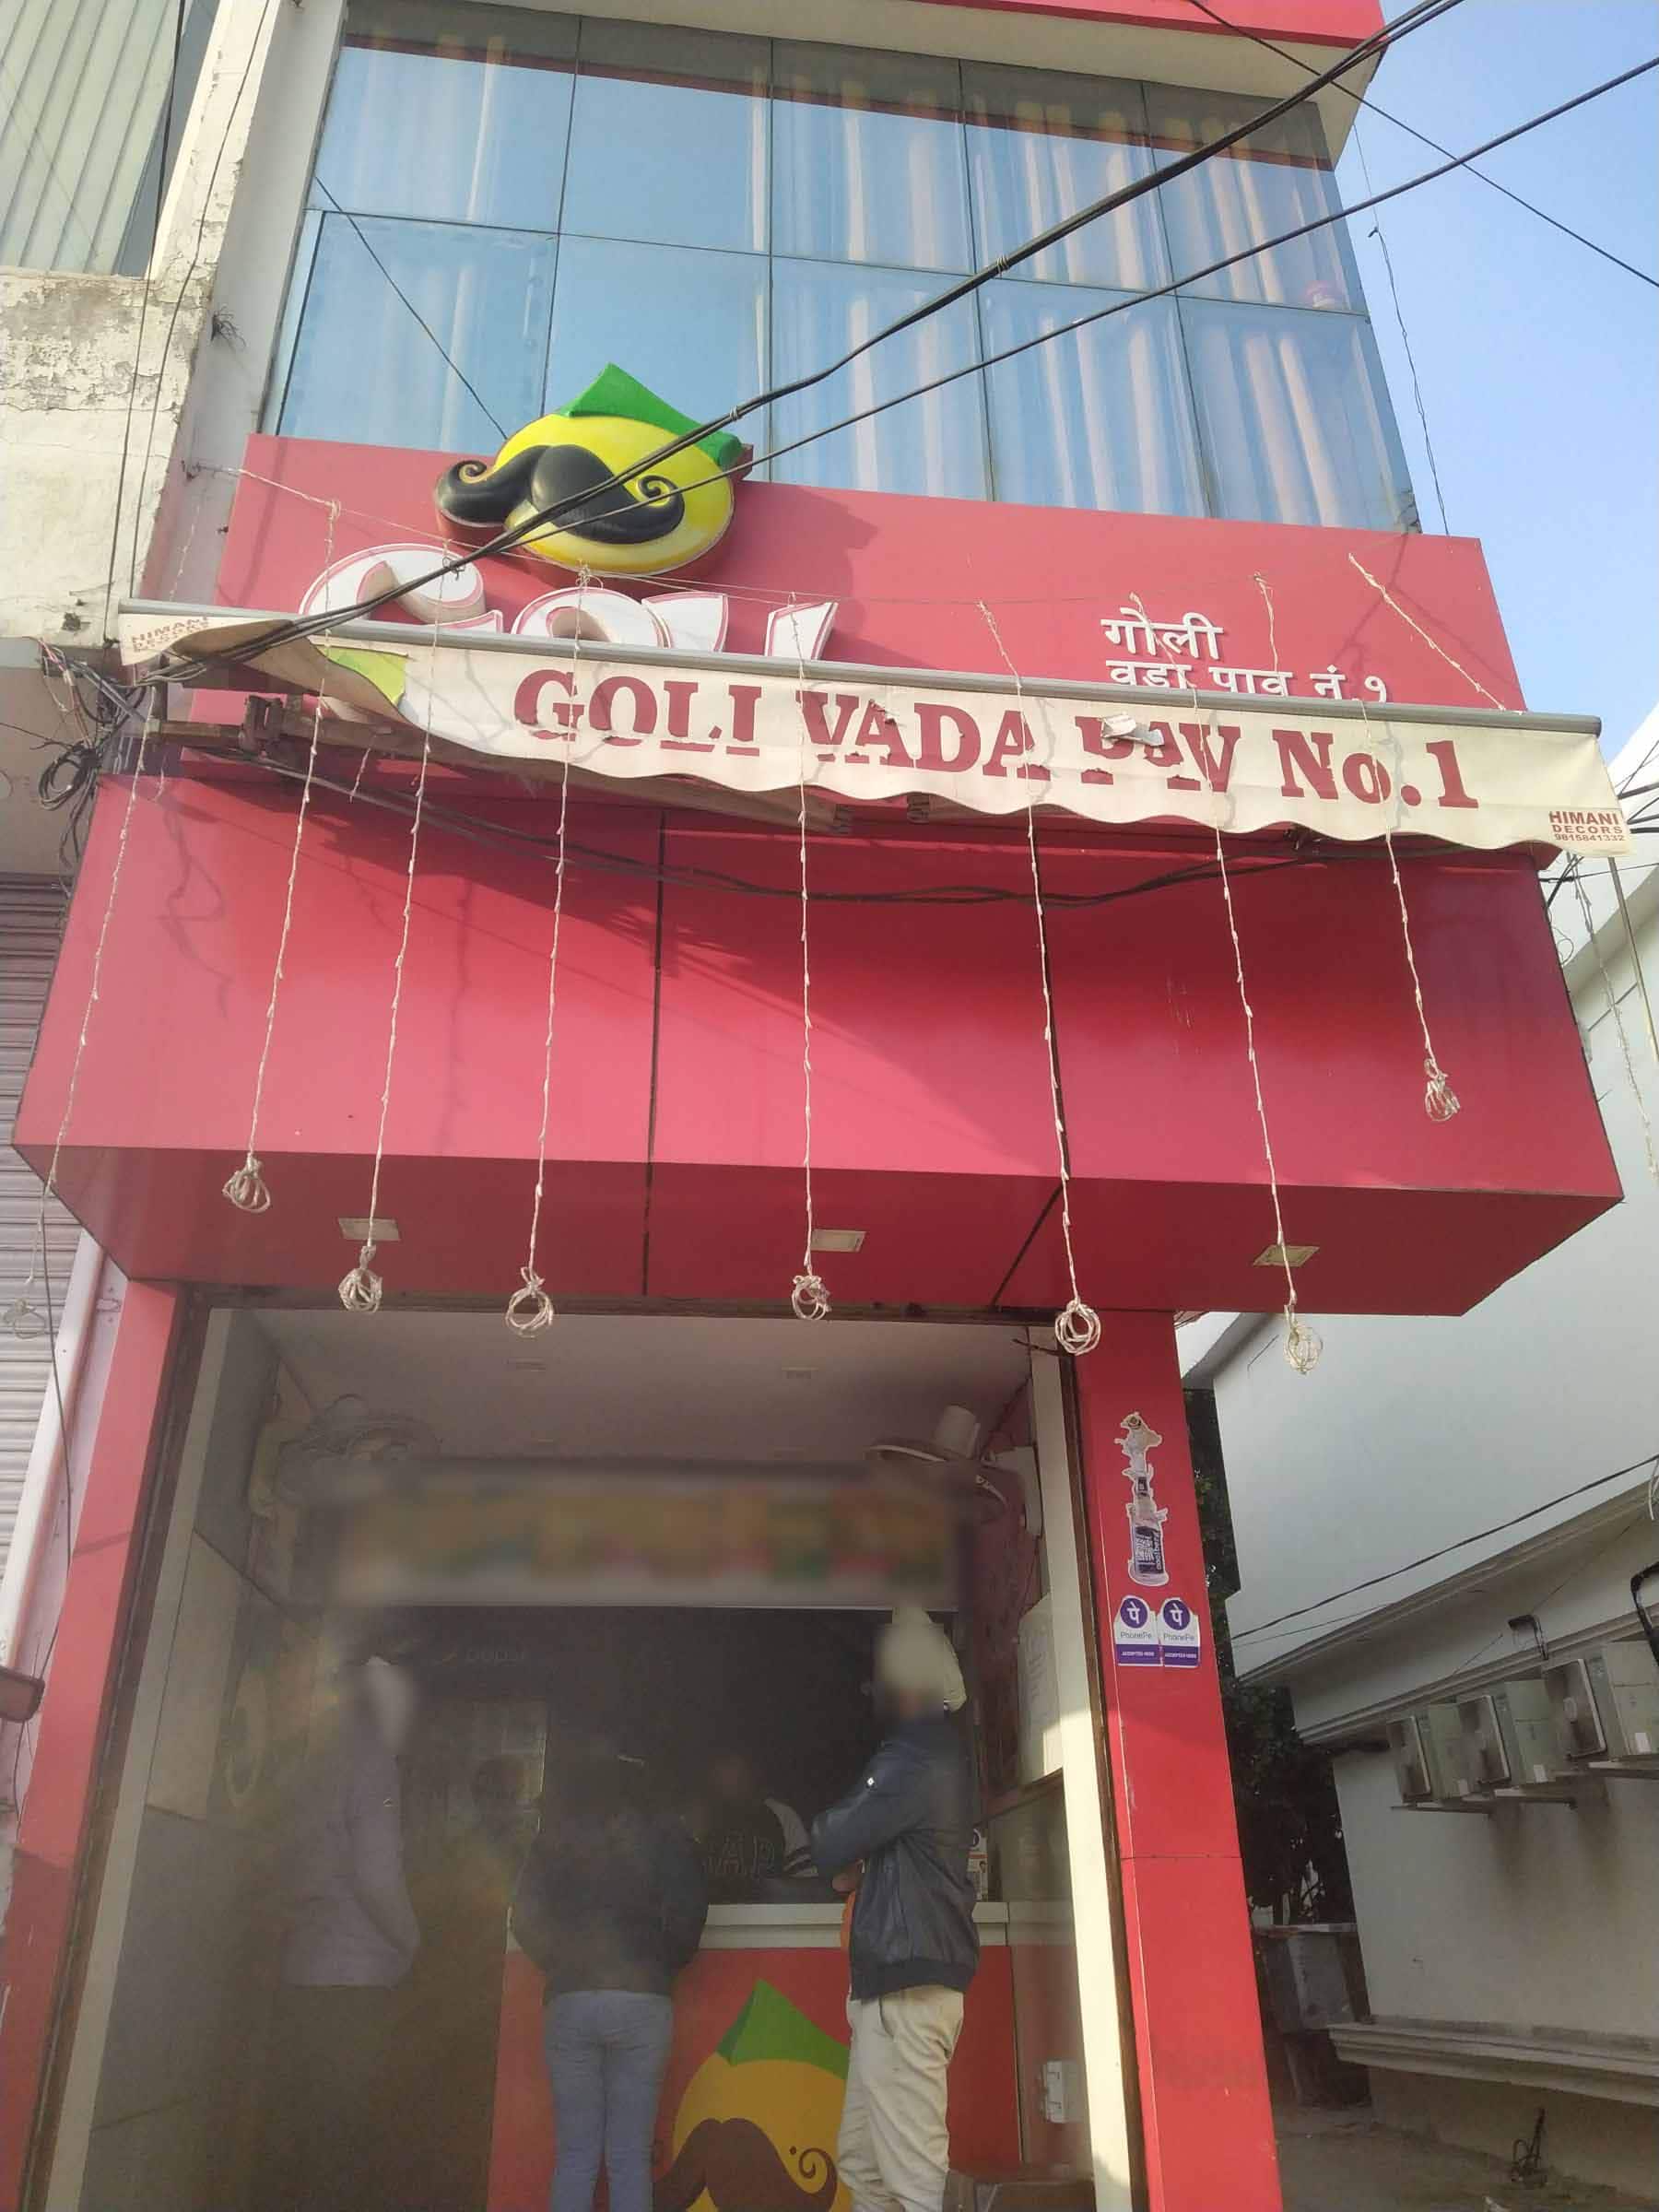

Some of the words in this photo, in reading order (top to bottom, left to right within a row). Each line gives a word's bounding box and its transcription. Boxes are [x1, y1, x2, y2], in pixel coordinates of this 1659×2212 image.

[1100, 606, 1224, 660] गोली
[514, 669, 762, 756] GOLI
[795, 690, 1052, 782] VADA
[1272, 729, 1479, 808] No.1
[1549, 811, 1619, 825] HIMANI
[1552, 824, 1623, 834] DECORS
